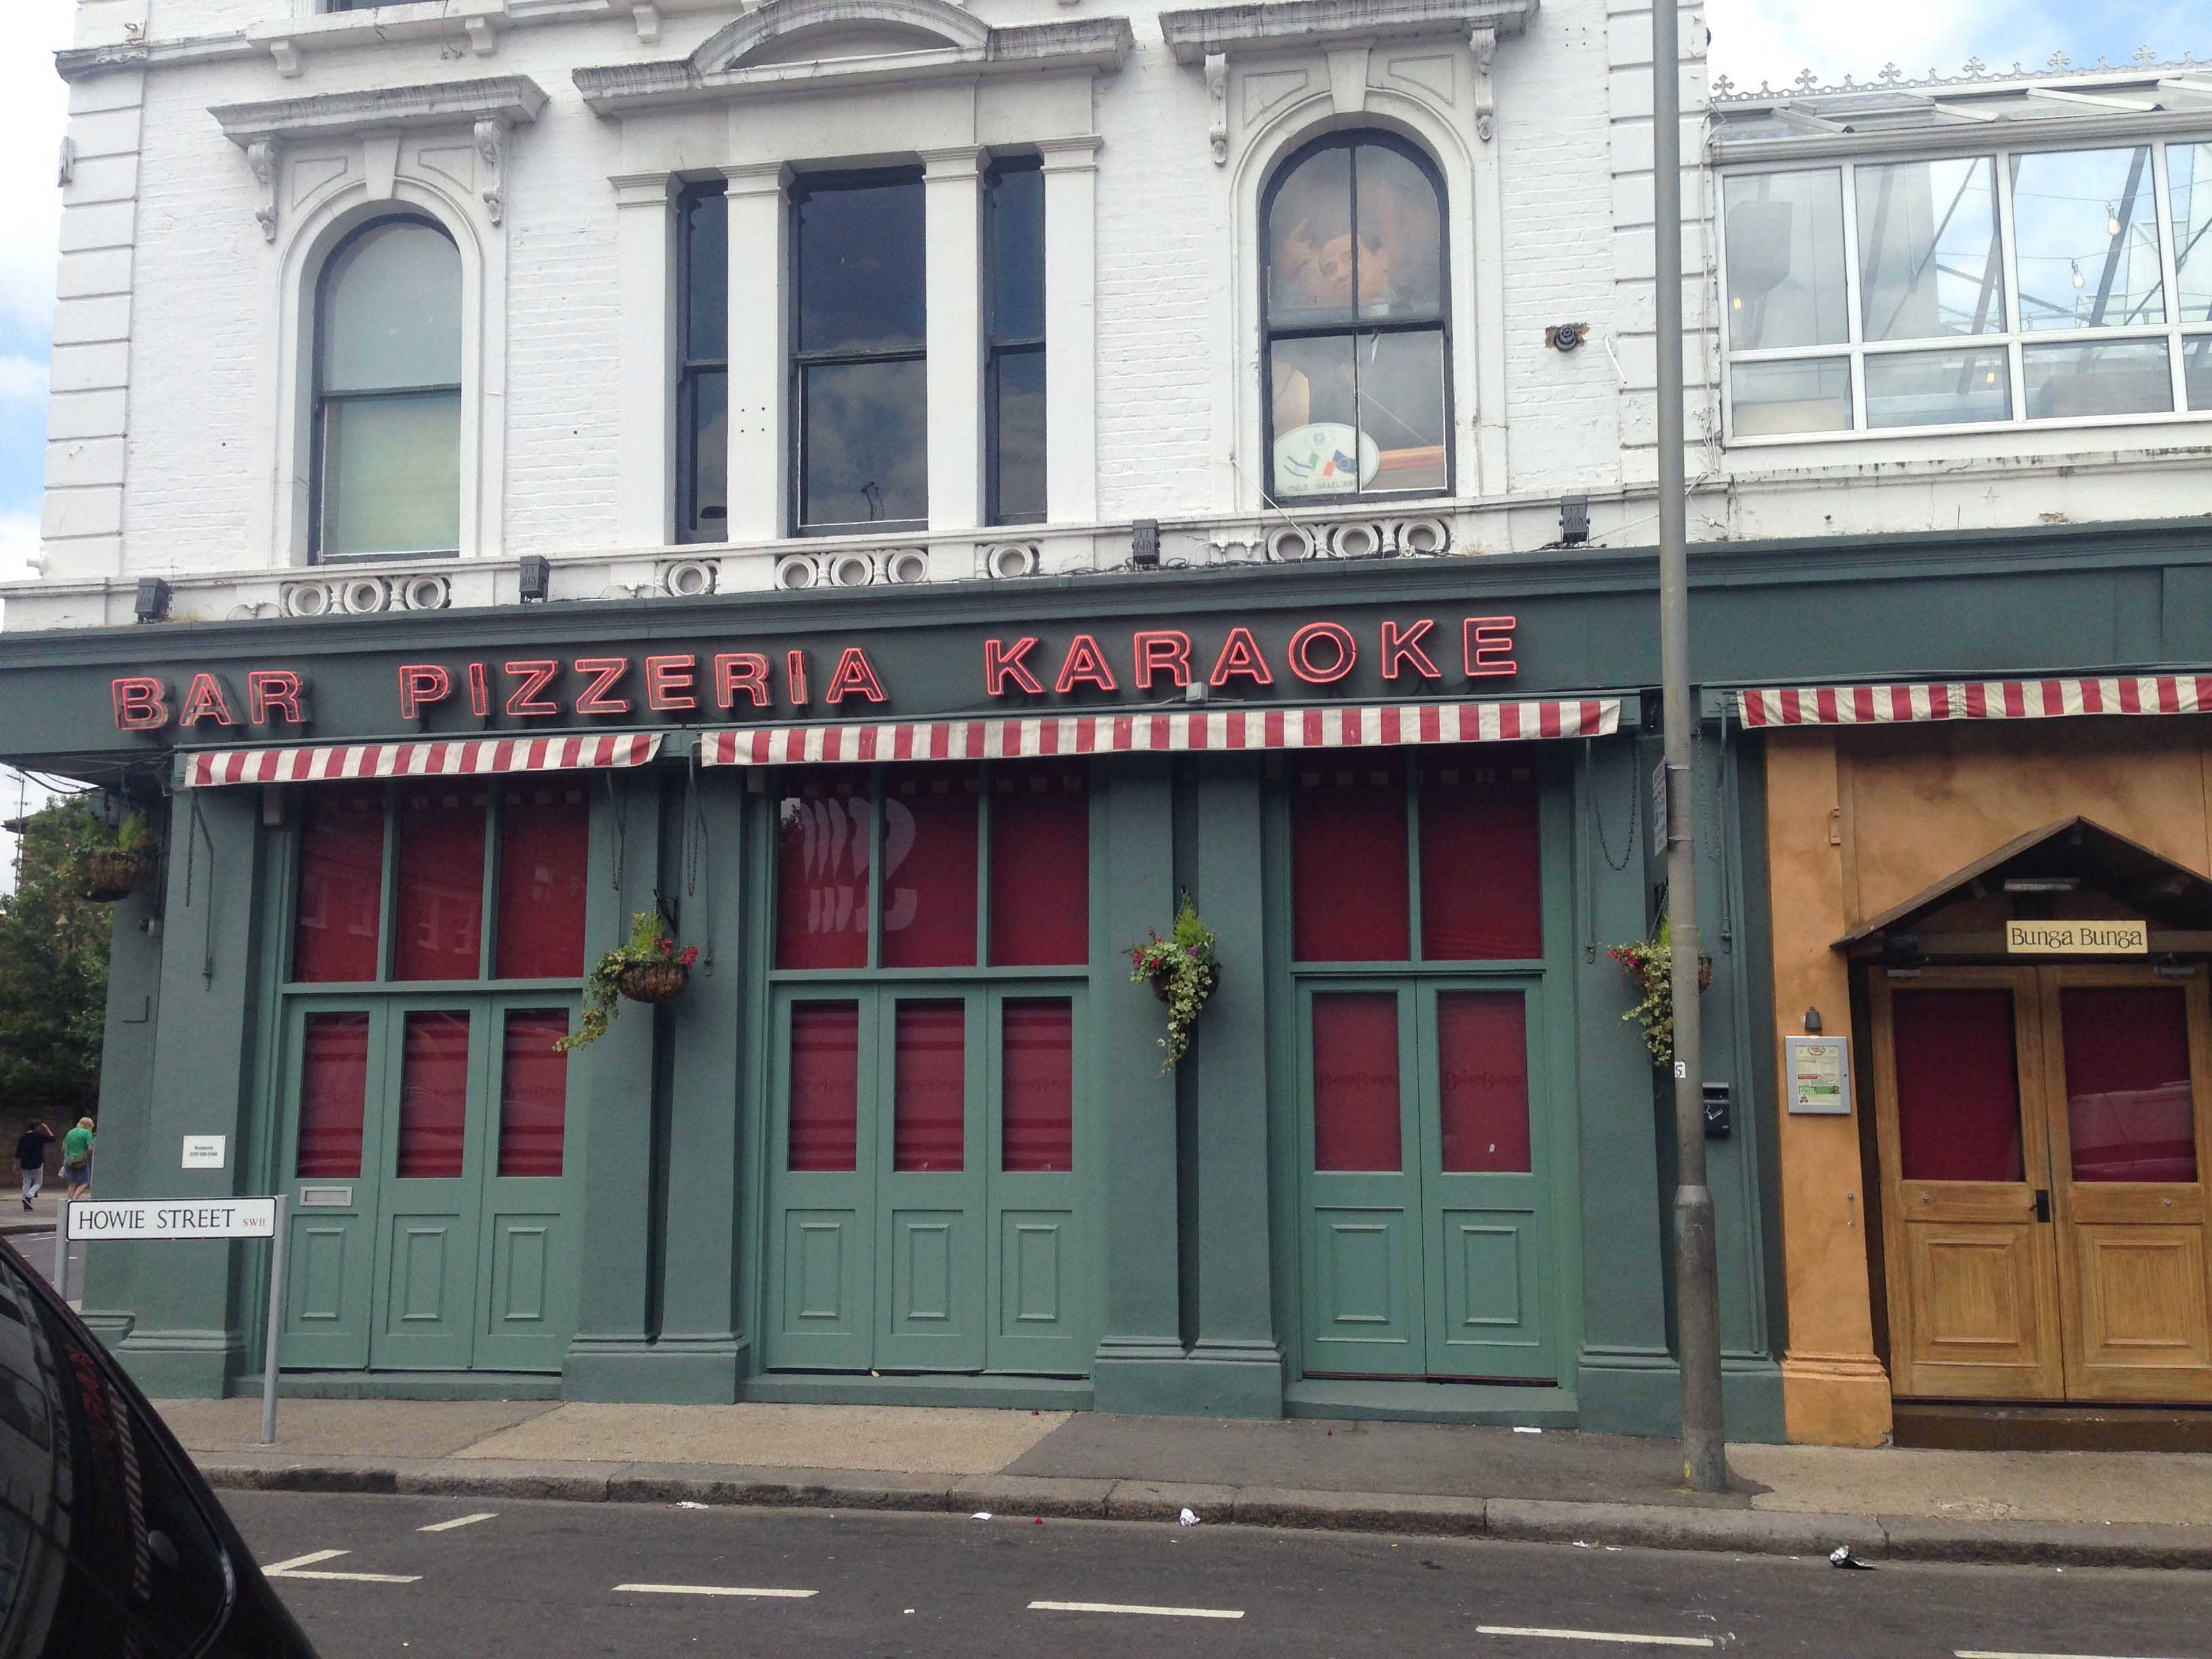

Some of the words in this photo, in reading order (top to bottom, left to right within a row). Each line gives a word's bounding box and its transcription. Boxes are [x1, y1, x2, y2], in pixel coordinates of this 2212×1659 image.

[111, 670, 307, 731] BAR
[398, 647, 888, 720] PIZZERIA
[985, 615, 1518, 697] KARAOKE
[2011, 927, 2074, 949] Bunga
[2080, 928, 2143, 949] Bunga
[78, 1210, 145, 1230] HOWIE
[157, 1208, 235, 1229] STREET
[242, 1217, 266, 1227] SW11
